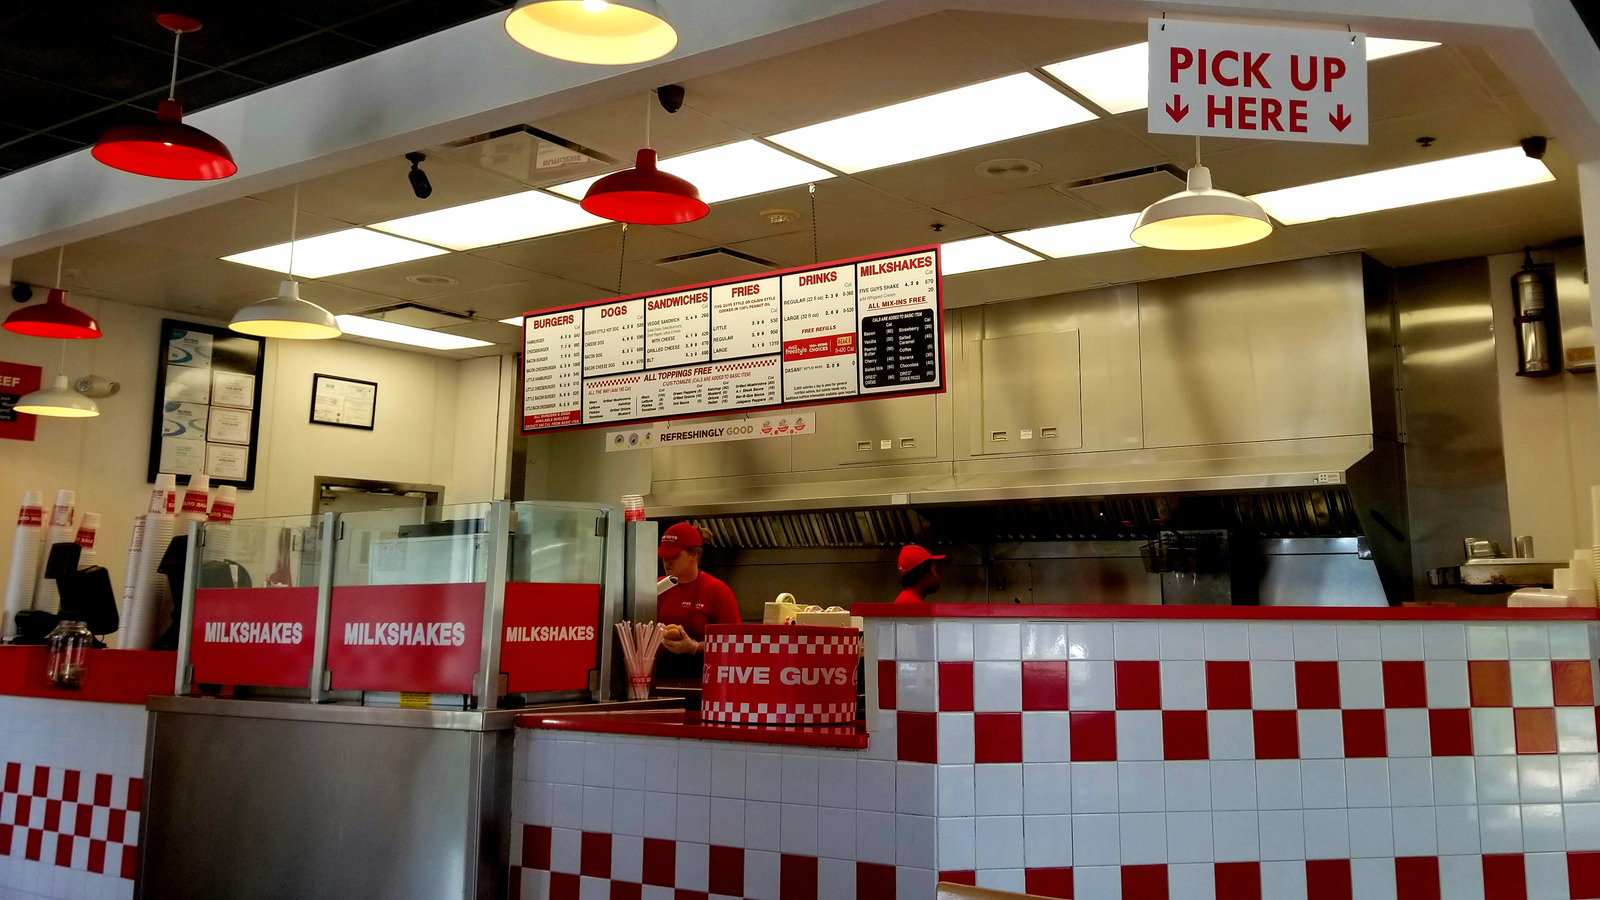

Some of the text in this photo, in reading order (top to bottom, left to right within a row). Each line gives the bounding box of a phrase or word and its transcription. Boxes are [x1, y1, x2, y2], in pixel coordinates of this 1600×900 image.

[1170, 47, 1346, 93] PICK UP
[1206, 94, 1308, 133] HERE
[860, 256, 933, 277] MILKSHAKES
[798, 271, 838, 287] DRINKS
[731, 283, 760, 299] FRIES
[870, 285, 883, 293] GUYS
[883, 282, 900, 291] SHAKE
[647, 291, 709, 311] SANDWICHES
[783, 298, 806, 306] REGULAR
[882, 299, 908, 308] MIX-INS
[908, 296, 927, 304] FREE
[600, 305, 628, 319] DOGS
[718, 305, 734, 313] COOKED
[533, 314, 575, 330] BURGERS
[646, 319, 661, 327] VEGGIE
[660, 317, 680, 325] SANDWICH
[713, 324, 727, 332] LITTLE
[815, 324, 837, 332] REFILLS
[584, 340, 597, 348] CHEESE
[660, 335, 676, 343] CHEESE
[713, 334, 734, 342] REGULAR
[646, 346, 664, 354] GRILLED
[664, 344, 681, 352] CHEESE
[713, 346, 728, 354] LARGE
[643, 366, 713, 382] ALL TOPPINGS FREE
[662, 379, 692, 387] CUSTOMIZE
[659, 425, 754, 443] REFRESHINGLY GOOD
[204, 621, 303, 651] MILKSHAKES
[343, 621, 466, 654] MILKSHAKES
[505, 625, 596, 644] MILKSHAKES
[717, 665, 771, 685] FIVE
[779, 667, 848, 686] GUYS
